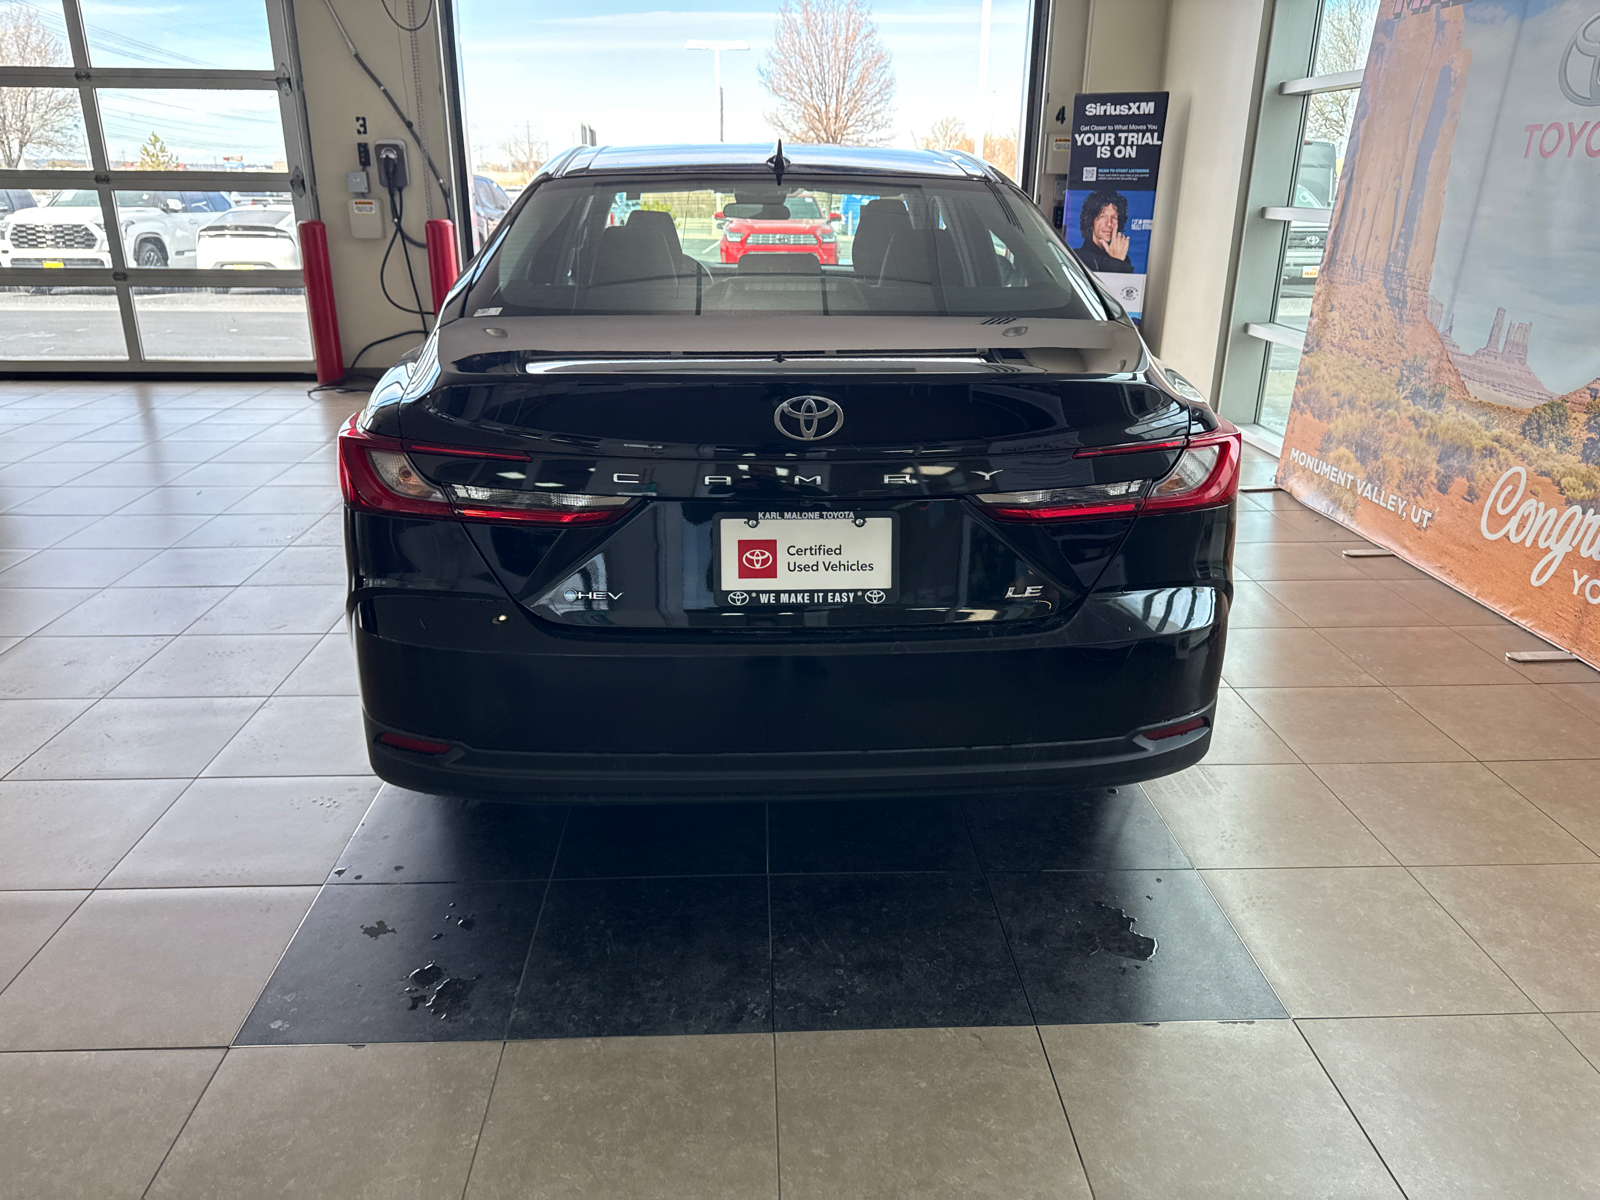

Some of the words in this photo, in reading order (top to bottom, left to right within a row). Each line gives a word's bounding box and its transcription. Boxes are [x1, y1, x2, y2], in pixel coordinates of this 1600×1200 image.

[1055, 106, 1066, 125] 4
[1085, 101, 1155, 116] SiriusXM
[355, 116, 368, 135] 3
[1074, 133, 1116, 146] YOUR
[1118, 132, 1162, 145] TRIAL
[1096, 146, 1111, 159] IS
[1113, 145, 1137, 159] ON
[612, 469, 1004, 486] CAMRY
[1289, 447, 1355, 490] MONUMENT
[1356, 478, 1408, 521] VALLEY,
[1410, 504, 1433, 528] UT
[758, 511, 782, 520] KARL
[784, 511, 820, 519] MALONE
[822, 511, 855, 519] TOYOTA
[786, 544, 842, 556] Certified
[787, 561, 819, 572] Used
[822, 560, 874, 572] Vehicles
[577, 591, 625, 600] HEV
[759, 593, 776, 603] WE
[780, 592, 810, 603] MAKE
[814, 592, 823, 603] IT
[827, 592, 855, 603] EASY
[1004, 585, 1044, 598] LE
